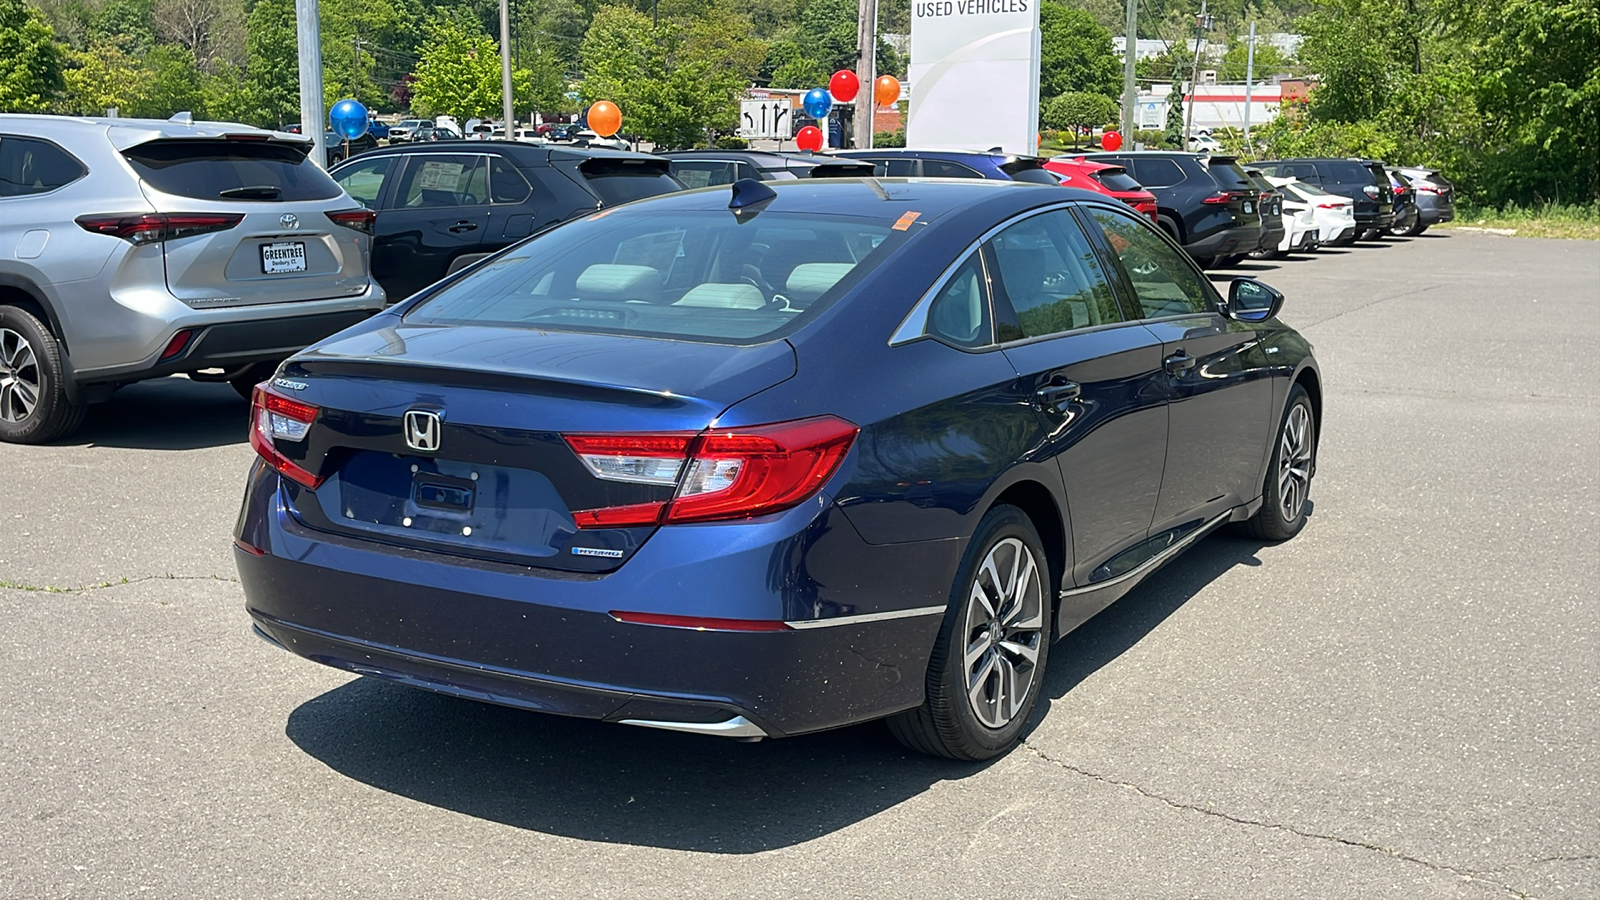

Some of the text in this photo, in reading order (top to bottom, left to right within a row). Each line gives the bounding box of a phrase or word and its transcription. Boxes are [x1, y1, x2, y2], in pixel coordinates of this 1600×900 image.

[917, 0, 1028, 17] USED VEHICLES
[264, 248, 303, 260] GREENTREE
[579, 549, 620, 557] HYBRID
